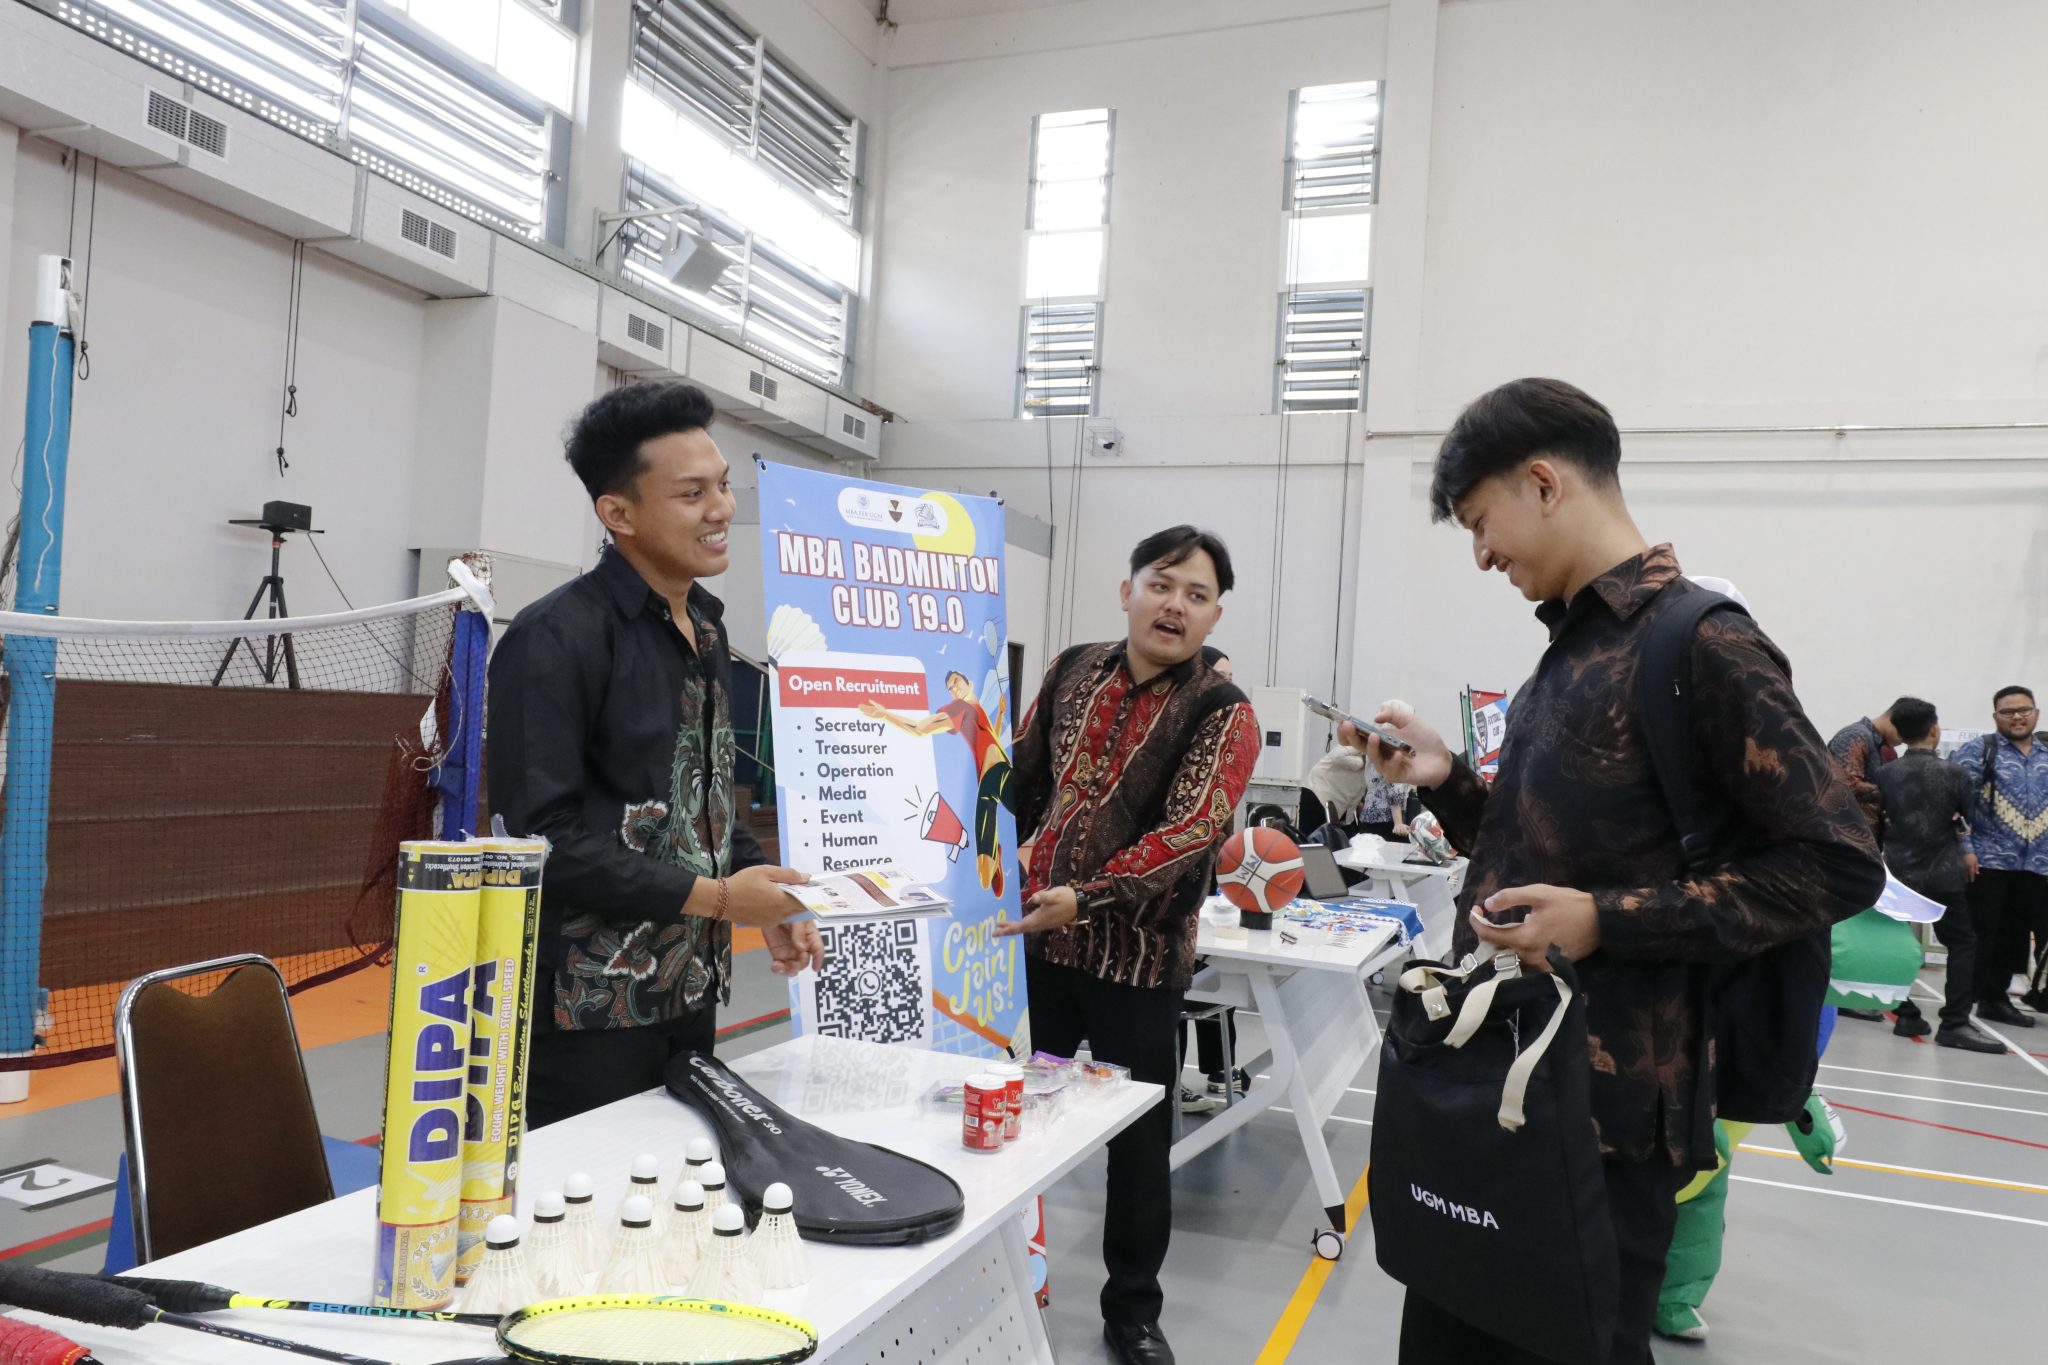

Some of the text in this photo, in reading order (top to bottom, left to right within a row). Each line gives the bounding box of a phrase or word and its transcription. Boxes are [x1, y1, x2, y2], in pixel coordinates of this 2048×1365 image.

[778, 532, 999, 595] MBA BADMINTON
[832, 585, 965, 634] CLUB 19.0
[789, 675, 920, 696] Open Recruitment
[815, 717, 886, 736] Secretary
[815, 740, 887, 755] Treasurer
[817, 763, 894, 781] Operation
[819, 785, 867, 801] Media
[820, 809, 864, 825] Event
[822, 832, 878, 848] Human
[424, 862, 461, 872] Shuttlecocks
[518, 941, 534, 1020] Shuttlecocks
[949, 948, 1007, 1016] join
[408, 966, 473, 1164] DIPA
[491, 957, 516, 1143] EQUAL WEIGHT WITH STABIL SPEED
[513, 1024, 527, 1094] Badminton
[690, 1056, 774, 1121] Carbonex
[763, 1121, 783, 1135] 30
[834, 1177, 888, 1205] YONEX
[1410, 1183, 1499, 1230] UGM MBA
